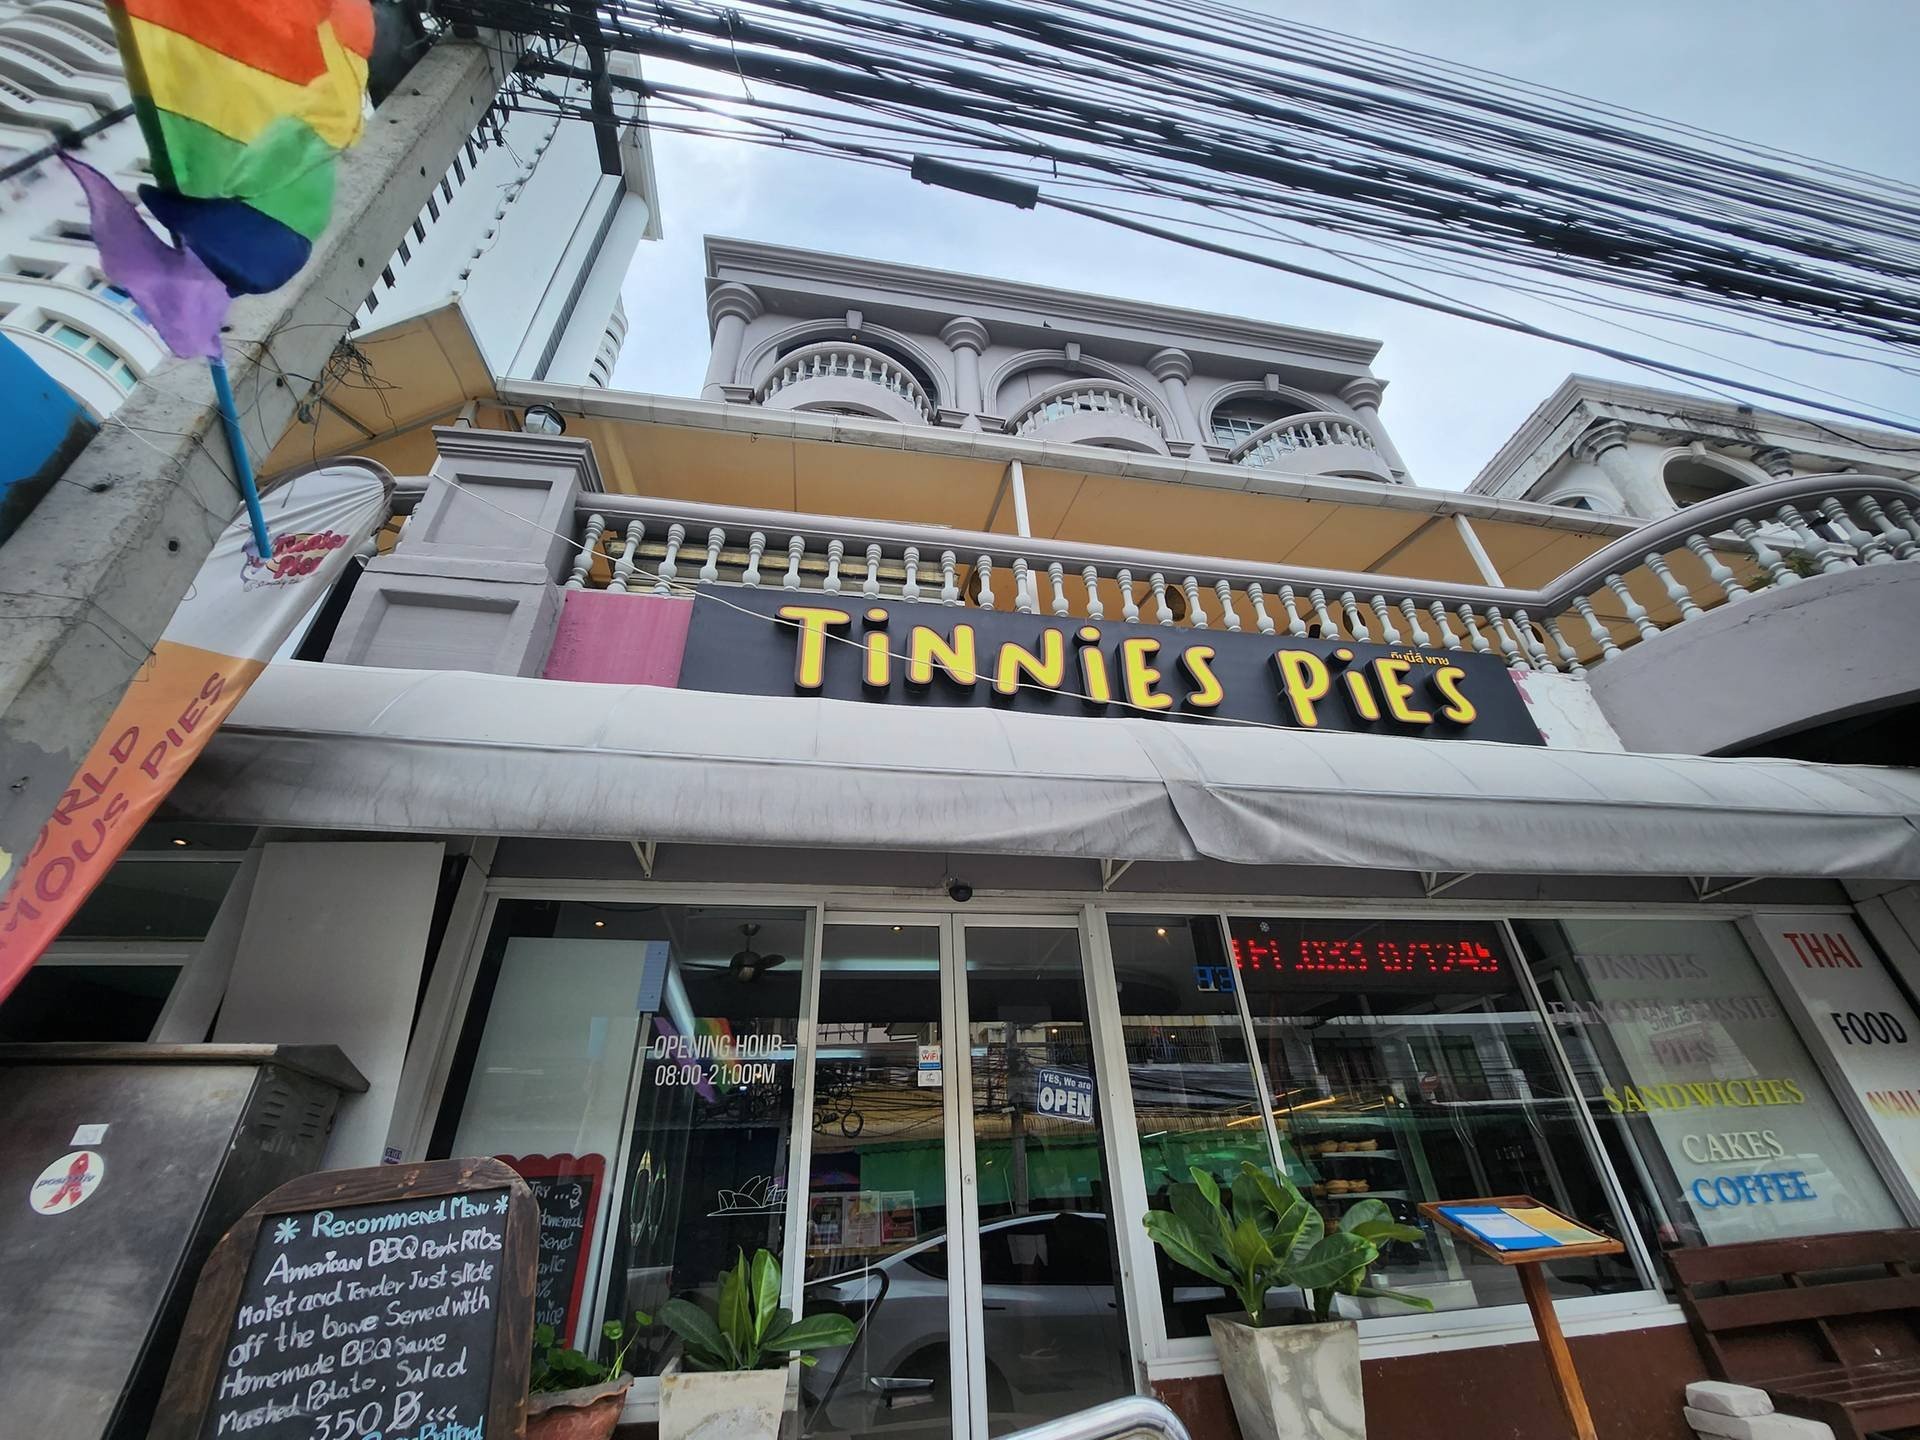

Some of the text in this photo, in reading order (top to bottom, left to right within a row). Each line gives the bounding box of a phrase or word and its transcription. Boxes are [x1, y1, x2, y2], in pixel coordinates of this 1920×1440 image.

[139, 672, 227, 780] PIES
[1783, 933, 1864, 969] THAI
[653, 1034, 783, 1060] OPENING HOUR
[1829, 1012, 1909, 1045] FOOD
[654, 1063, 776, 1086] 08:00-21:00PM
[1043, 1073, 1091, 1090] YES, We are
[1040, 1086, 1091, 1117] OPEN
[1602, 1078, 1805, 1114] SANDWICHES
[1682, 1130, 1785, 1164] CAKES
[1692, 1171, 1818, 1210] COFFEE
[312, 1196, 489, 1239] Recommend Menu
[263, 1251, 362, 1286] American
[367, 1235, 419, 1267] BBQ
[421, 1233, 459, 1259] Pork
[298, 1280, 344, 1311] and
[346, 1275, 405, 1300] Tender
[408, 1264, 447, 1290] Just
[451, 1259, 494, 1286] slide
[227, 1287, 491, 1367] off the bone Served with
[219, 1332, 447, 1400] Homemade BBQ Sauce
[217, 1393, 301, 1436] Mashed
[396, 1346, 468, 1387] Salad
[310, 1402, 383, 1440] 350
